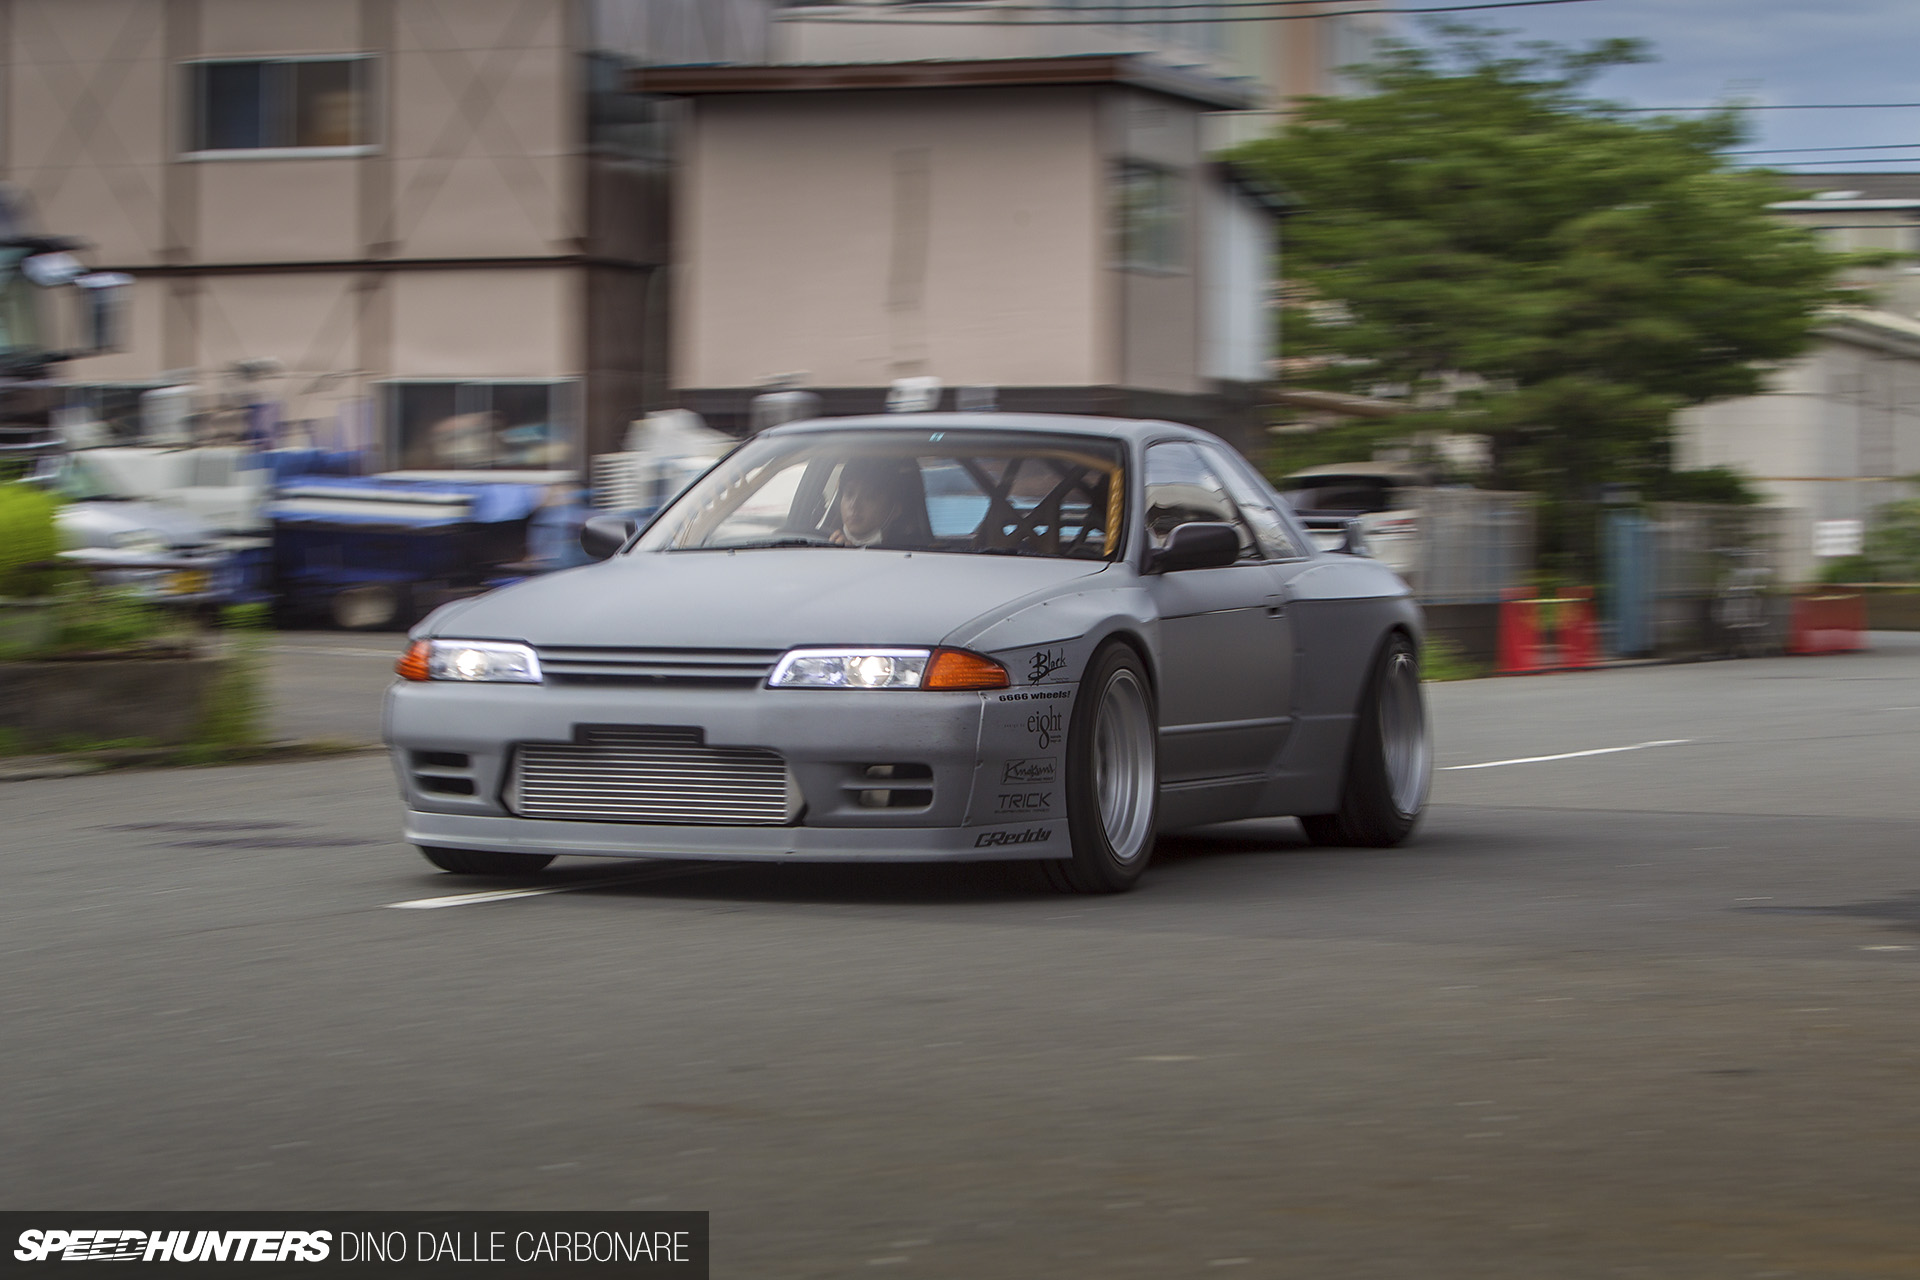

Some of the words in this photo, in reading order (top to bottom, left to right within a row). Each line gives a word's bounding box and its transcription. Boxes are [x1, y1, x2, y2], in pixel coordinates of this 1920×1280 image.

[1028, 648, 1067, 686] Black
[999, 692, 1028, 702] 6666
[1031, 690, 1071, 700] wheels!
[1027, 705, 1062, 749] eight
[998, 792, 1052, 808] TRICK
[974, 828, 1052, 848] GReddy
